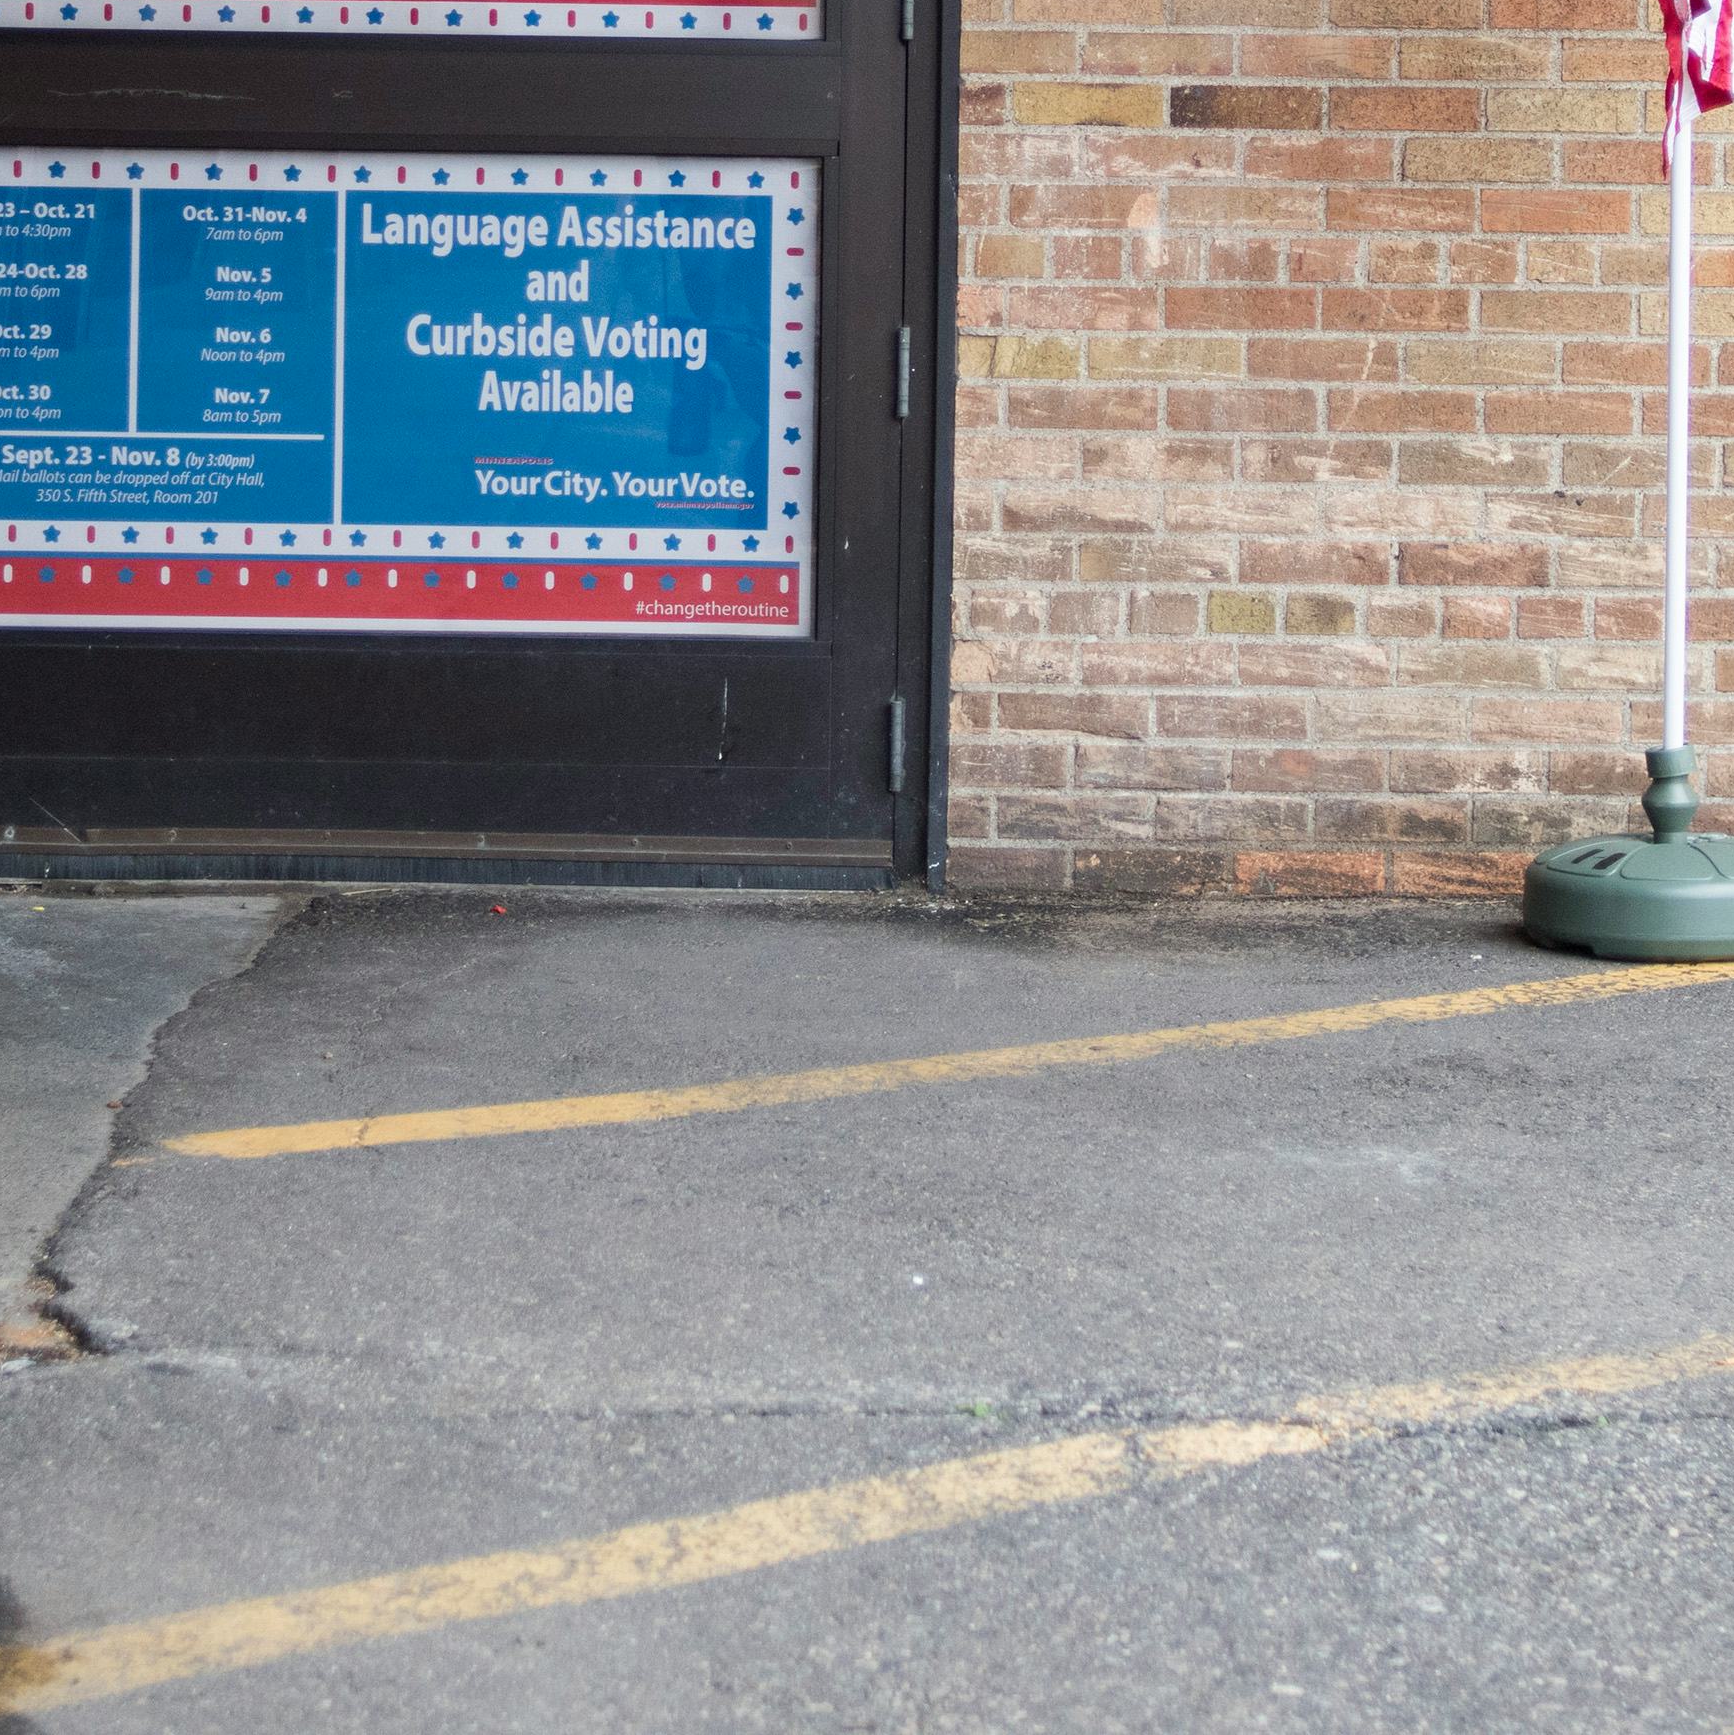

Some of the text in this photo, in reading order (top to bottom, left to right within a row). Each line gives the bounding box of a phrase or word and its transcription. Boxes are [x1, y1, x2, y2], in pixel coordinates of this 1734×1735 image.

[33, 201, 71, 219] Oct.
[74, 203, 95, 219] 21
[182, 204, 308, 224] Oct. 31-Nov. 4
[4, 224, 20, 237] to
[21, 223, 72, 240] 4:30pm
[205, 226, 284, 244] 7am to 6pm
[361, 201, 757, 259] Language Assistance
[64, 263, 88, 280] 28
[216, 266, 272, 284] Nov. 5
[525, 258, 590, 303] and
[14, 285, 29, 298] to
[30, 284, 61, 301] 6pm
[204, 287, 284, 305] 9am to 4pm
[28, 323, 53, 340] 29
[215, 326, 272, 344] Nov. 6
[405, 312, 708, 373] Curbside Voting
[13, 345, 28, 358] to
[29, 345, 60, 362] 4pm
[200, 347, 286, 366] Noon to 4pm
[28, 384, 52, 401] 30
[214, 387, 271, 404] Nov. 7
[478, 368, 634, 414] Available
[15, 406, 30, 419] to
[31, 405, 62, 422] 4pm
[202, 408, 282, 426] 8am to 5pm
[1, 444, 61, 469] Sept.
[64, 445, 93, 466] 23
[110, 445, 162, 467] Nov.
[165, 446, 181, 467] 8
[184, 451, 255, 470] (by 3:00pm)
[21, 468, 66, 485] ballots
[67, 472, 93, 485] can
[94, 470, 112, 485] be
[113, 470, 168, 489] dropped
[170, 471, 190, 487] off
[191, 473, 206, 486] at
[207, 471, 234, 490] City
[235, 472, 266, 488] Hall,
[36, 488, 219, 506] 350 S. Fifth Street, Room 201
[635, 599, 789, 620] #changetheroutine
